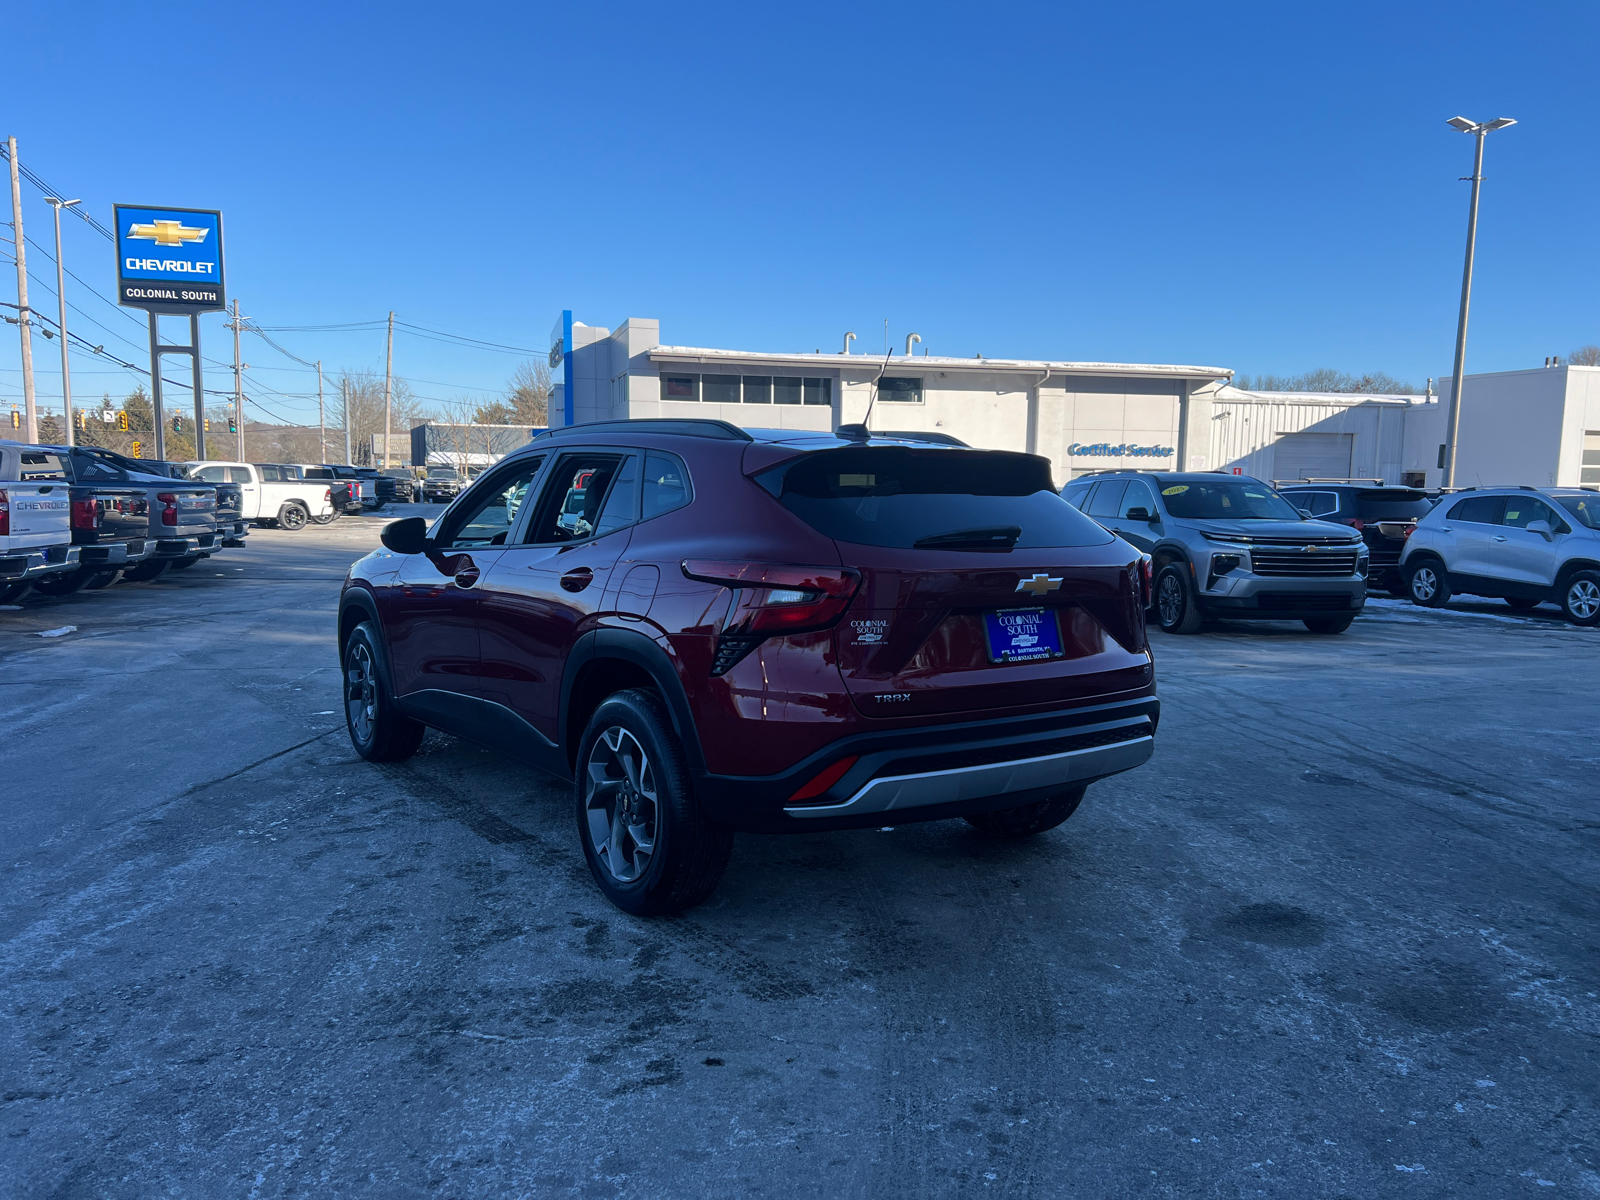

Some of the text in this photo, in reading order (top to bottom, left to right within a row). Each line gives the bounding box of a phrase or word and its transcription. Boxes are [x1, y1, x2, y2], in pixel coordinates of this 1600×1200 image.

[126, 258, 214, 273] CHEVROLET
[126, 288, 216, 301] COLONIAL SOUTH
[1071, 443, 1174, 456] Certified Service
[1168, 486, 1185, 494] 2025
[16, 501, 69, 510] CHEVROLET
[999, 614, 1043, 626] COLONIAL
[1007, 624, 1038, 635] SOUTH
[874, 693, 911, 703] TRAX
